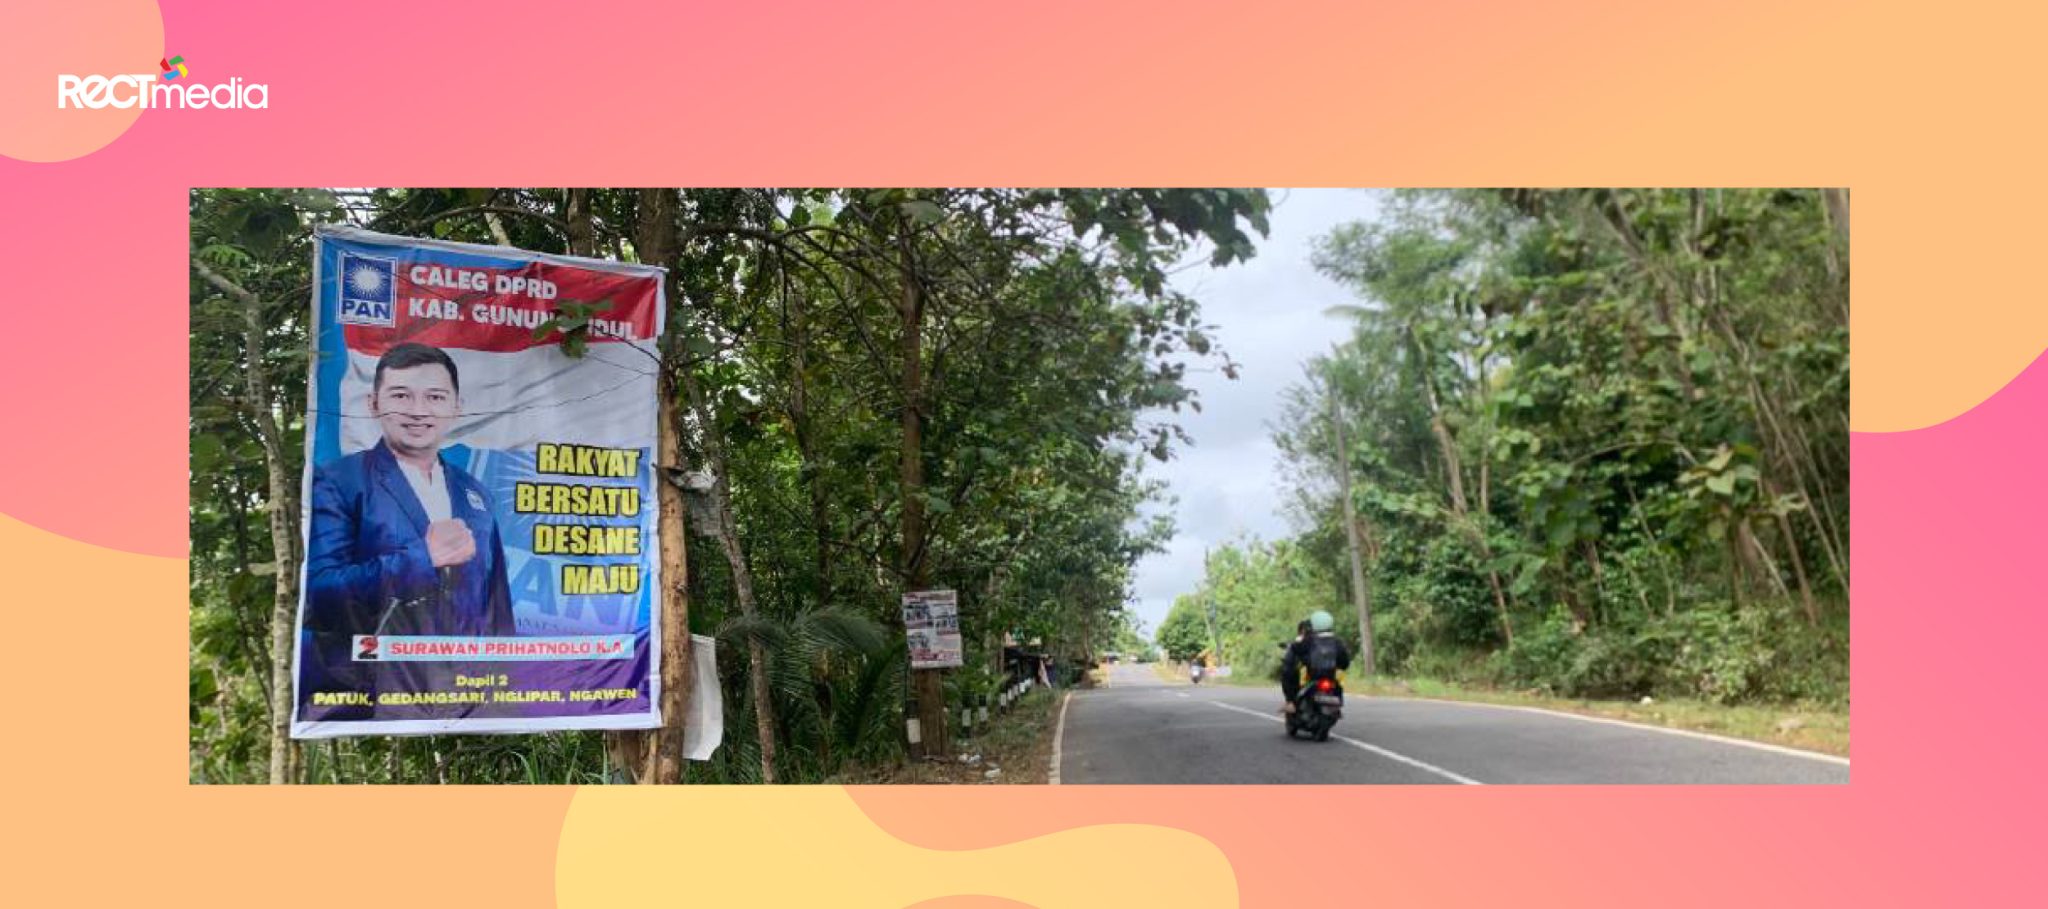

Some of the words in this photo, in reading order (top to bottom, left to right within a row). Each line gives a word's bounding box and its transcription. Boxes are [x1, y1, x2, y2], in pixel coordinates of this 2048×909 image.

[410, 266, 488, 292] CALEG
[495, 275, 557, 300] DPRD
[341, 300, 391, 319] PAN
[409, 298, 464, 321] KAB.
[472, 304, 638, 340] GUNUNIDUL
[537, 443, 641, 477] RAKYAT
[516, 482, 640, 516] BERSATU
[533, 524, 640, 555] DESANE
[562, 564, 639, 594] MAJU
[358, 636, 379, 660] 2
[391, 642, 479, 655] SURAWAN
[485, 642, 591, 655] PRIHATNOLO
[456, 674, 495, 688] Dapil
[498, 674, 509, 686] 2
[569, 688, 637, 701] NGAWEN
